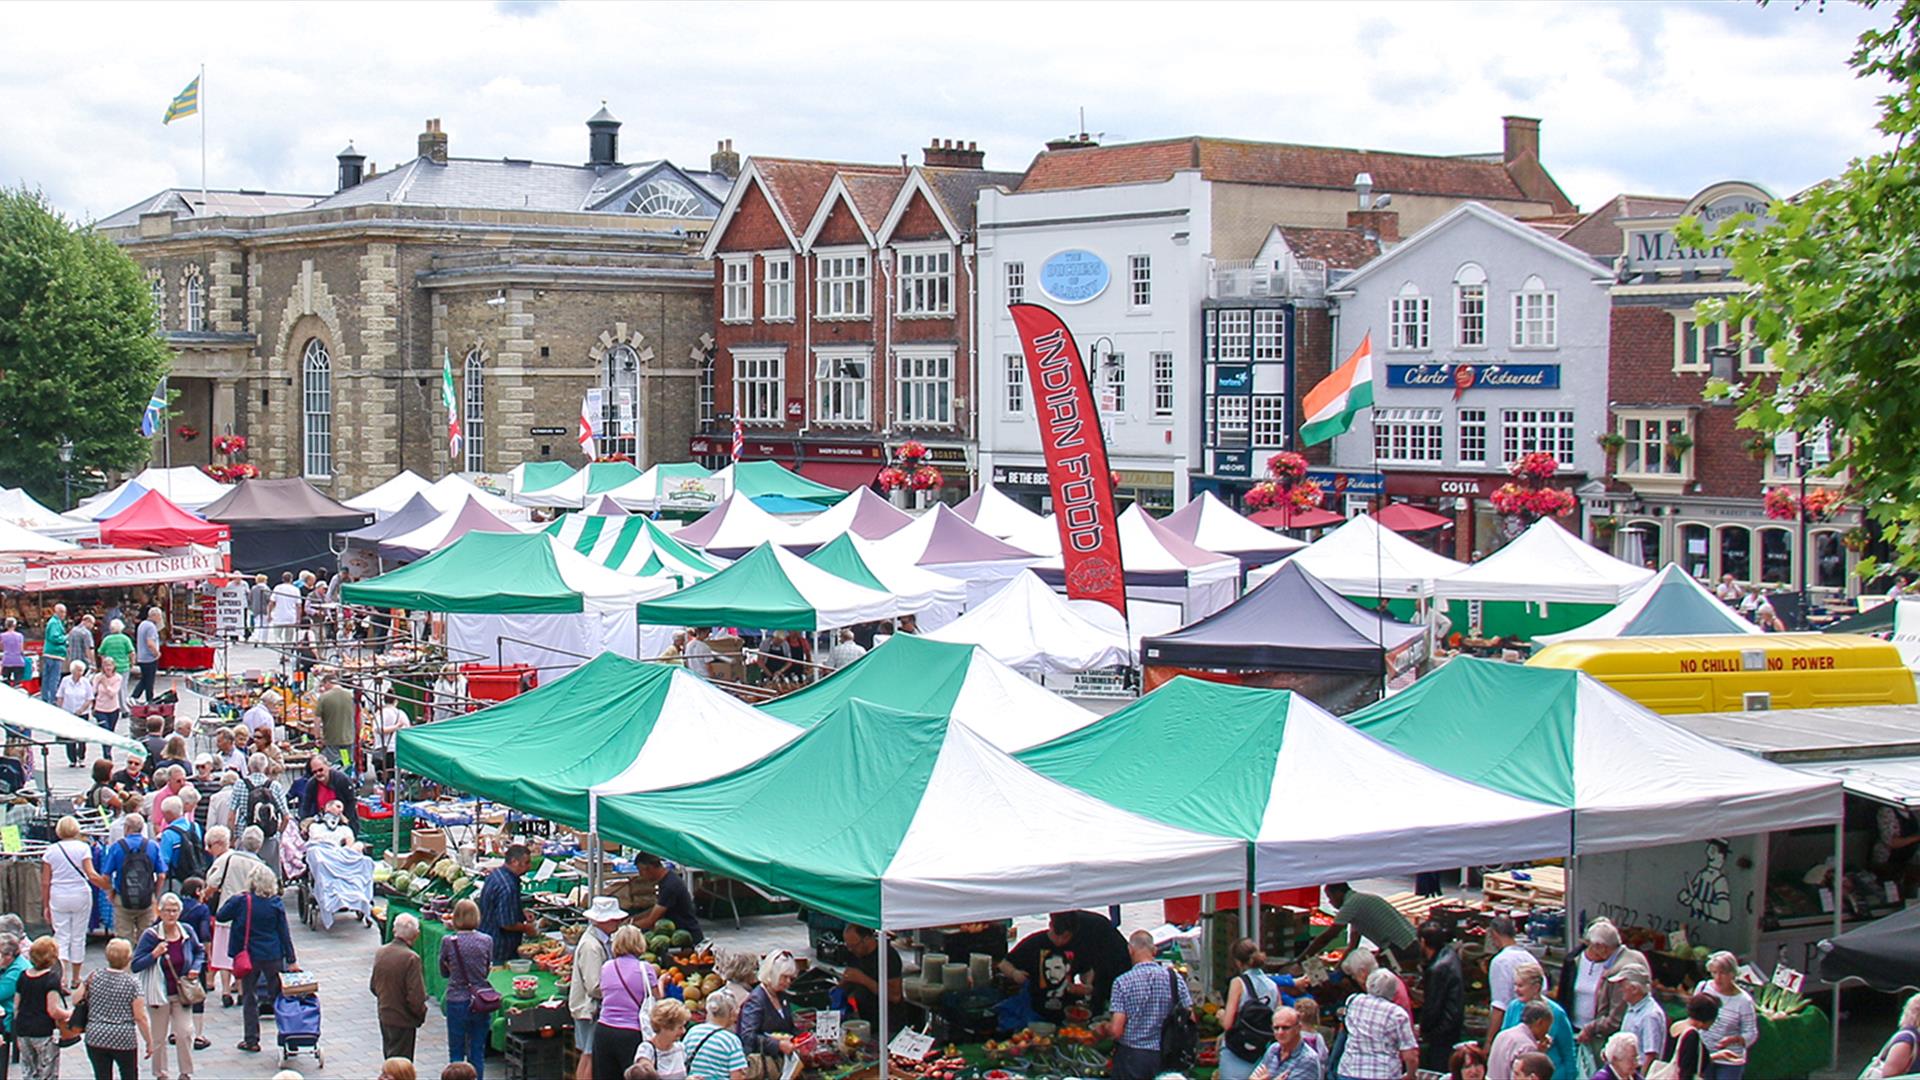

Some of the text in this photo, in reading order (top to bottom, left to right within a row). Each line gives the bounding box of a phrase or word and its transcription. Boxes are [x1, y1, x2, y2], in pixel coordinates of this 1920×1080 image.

[1047, 262, 1101, 277] DUCHESS
[1404, 367, 1545, 385] Charter Restaurant
[1034, 328, 1104, 552] INDIAN FOOD
[1008, 472, 1018, 484] BE
[1019, 472, 1033, 484] THE
[1033, 473, 1050, 485] BES
[1440, 481, 1480, 494] COSTA
[49, 554, 210, 581] ROSES of SALISBURY
[1680, 656, 1835, 673] NO CHILLI NO POWER
[1647, 913, 1700, 942] 32436
